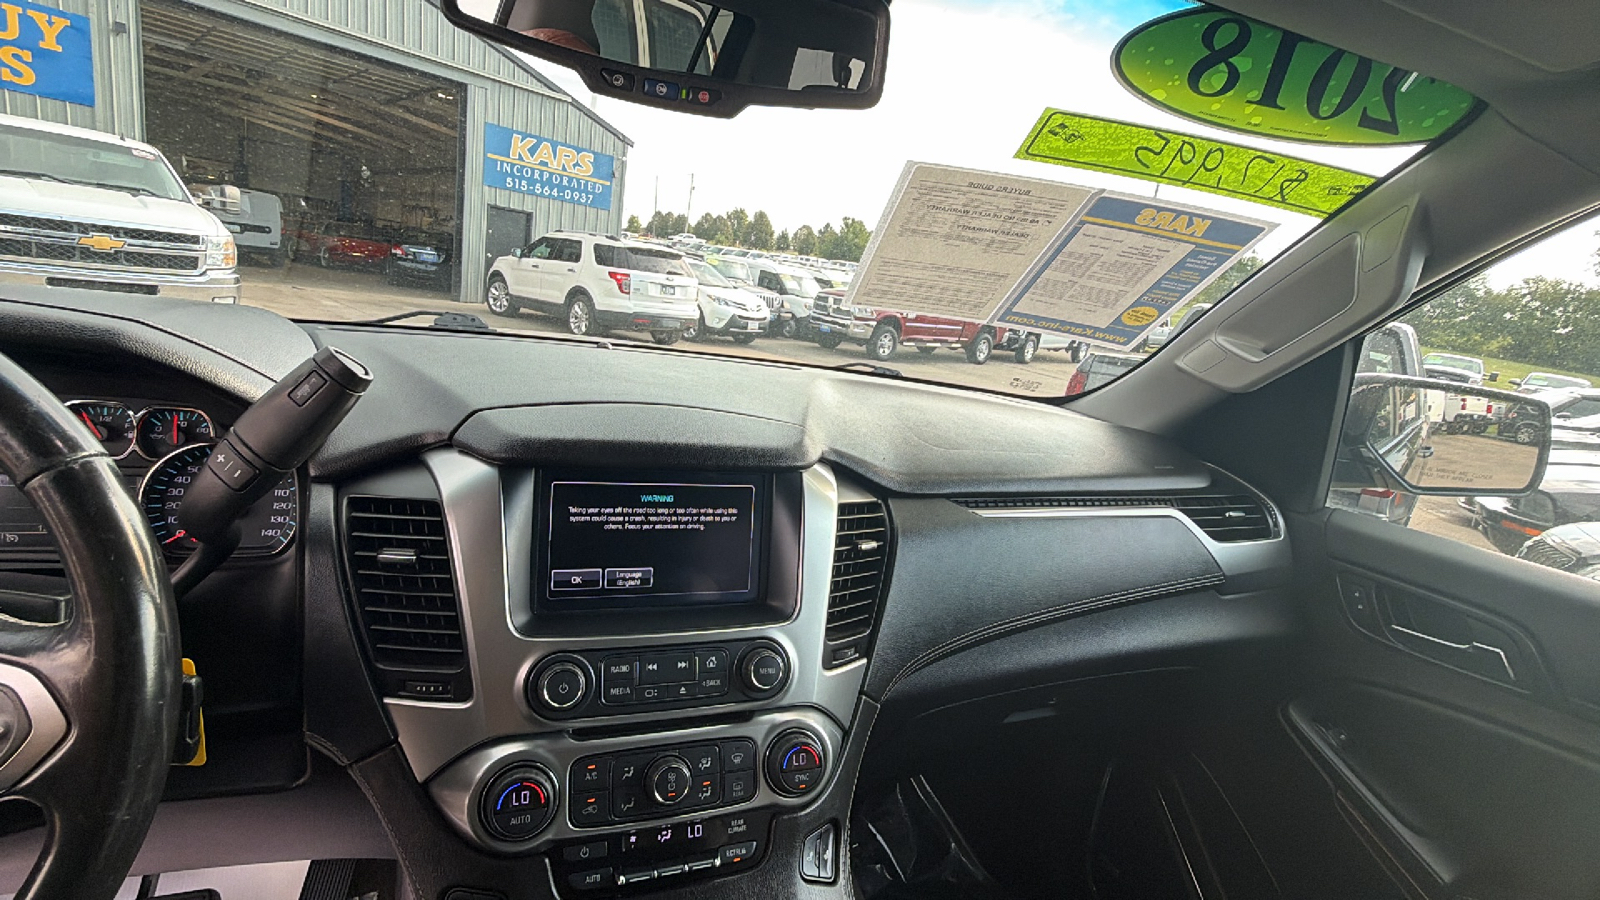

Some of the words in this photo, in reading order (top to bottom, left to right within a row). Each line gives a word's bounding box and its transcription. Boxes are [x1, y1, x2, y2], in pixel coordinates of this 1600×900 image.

[509, 133, 594, 176] KARS
[496, 160, 603, 194] INCORPORATED
[505, 177, 593, 204] 515-564-0937
[174, 476, 191, 484] 40
[167, 488, 184, 496] 30
[274, 489, 290, 497] 110
[640, 494, 674, 502] WARNING
[273, 502, 292, 510] 120
[568, 506, 586, 514] Taking
[657, 507, 669, 515] long
[686, 506, 699, 514] often
[714, 507, 727, 515] using
[261, 529, 281, 537] 140
[571, 576, 583, 584] OK
[616, 579, 641, 587] (English)
[610, 664, 630, 673] RADIO
[759, 667, 776, 675] MENU
[706, 679, 721, 687] BACK
[610, 687, 631, 696] MEDIA
[585, 771, 598, 780] A/C
[794, 773, 810, 782] SYNC
[512, 790, 530, 806] LO
[510, 814, 531, 825] AUTO
[687, 824, 703, 838] LO
[585, 874, 600, 883] AUTO
